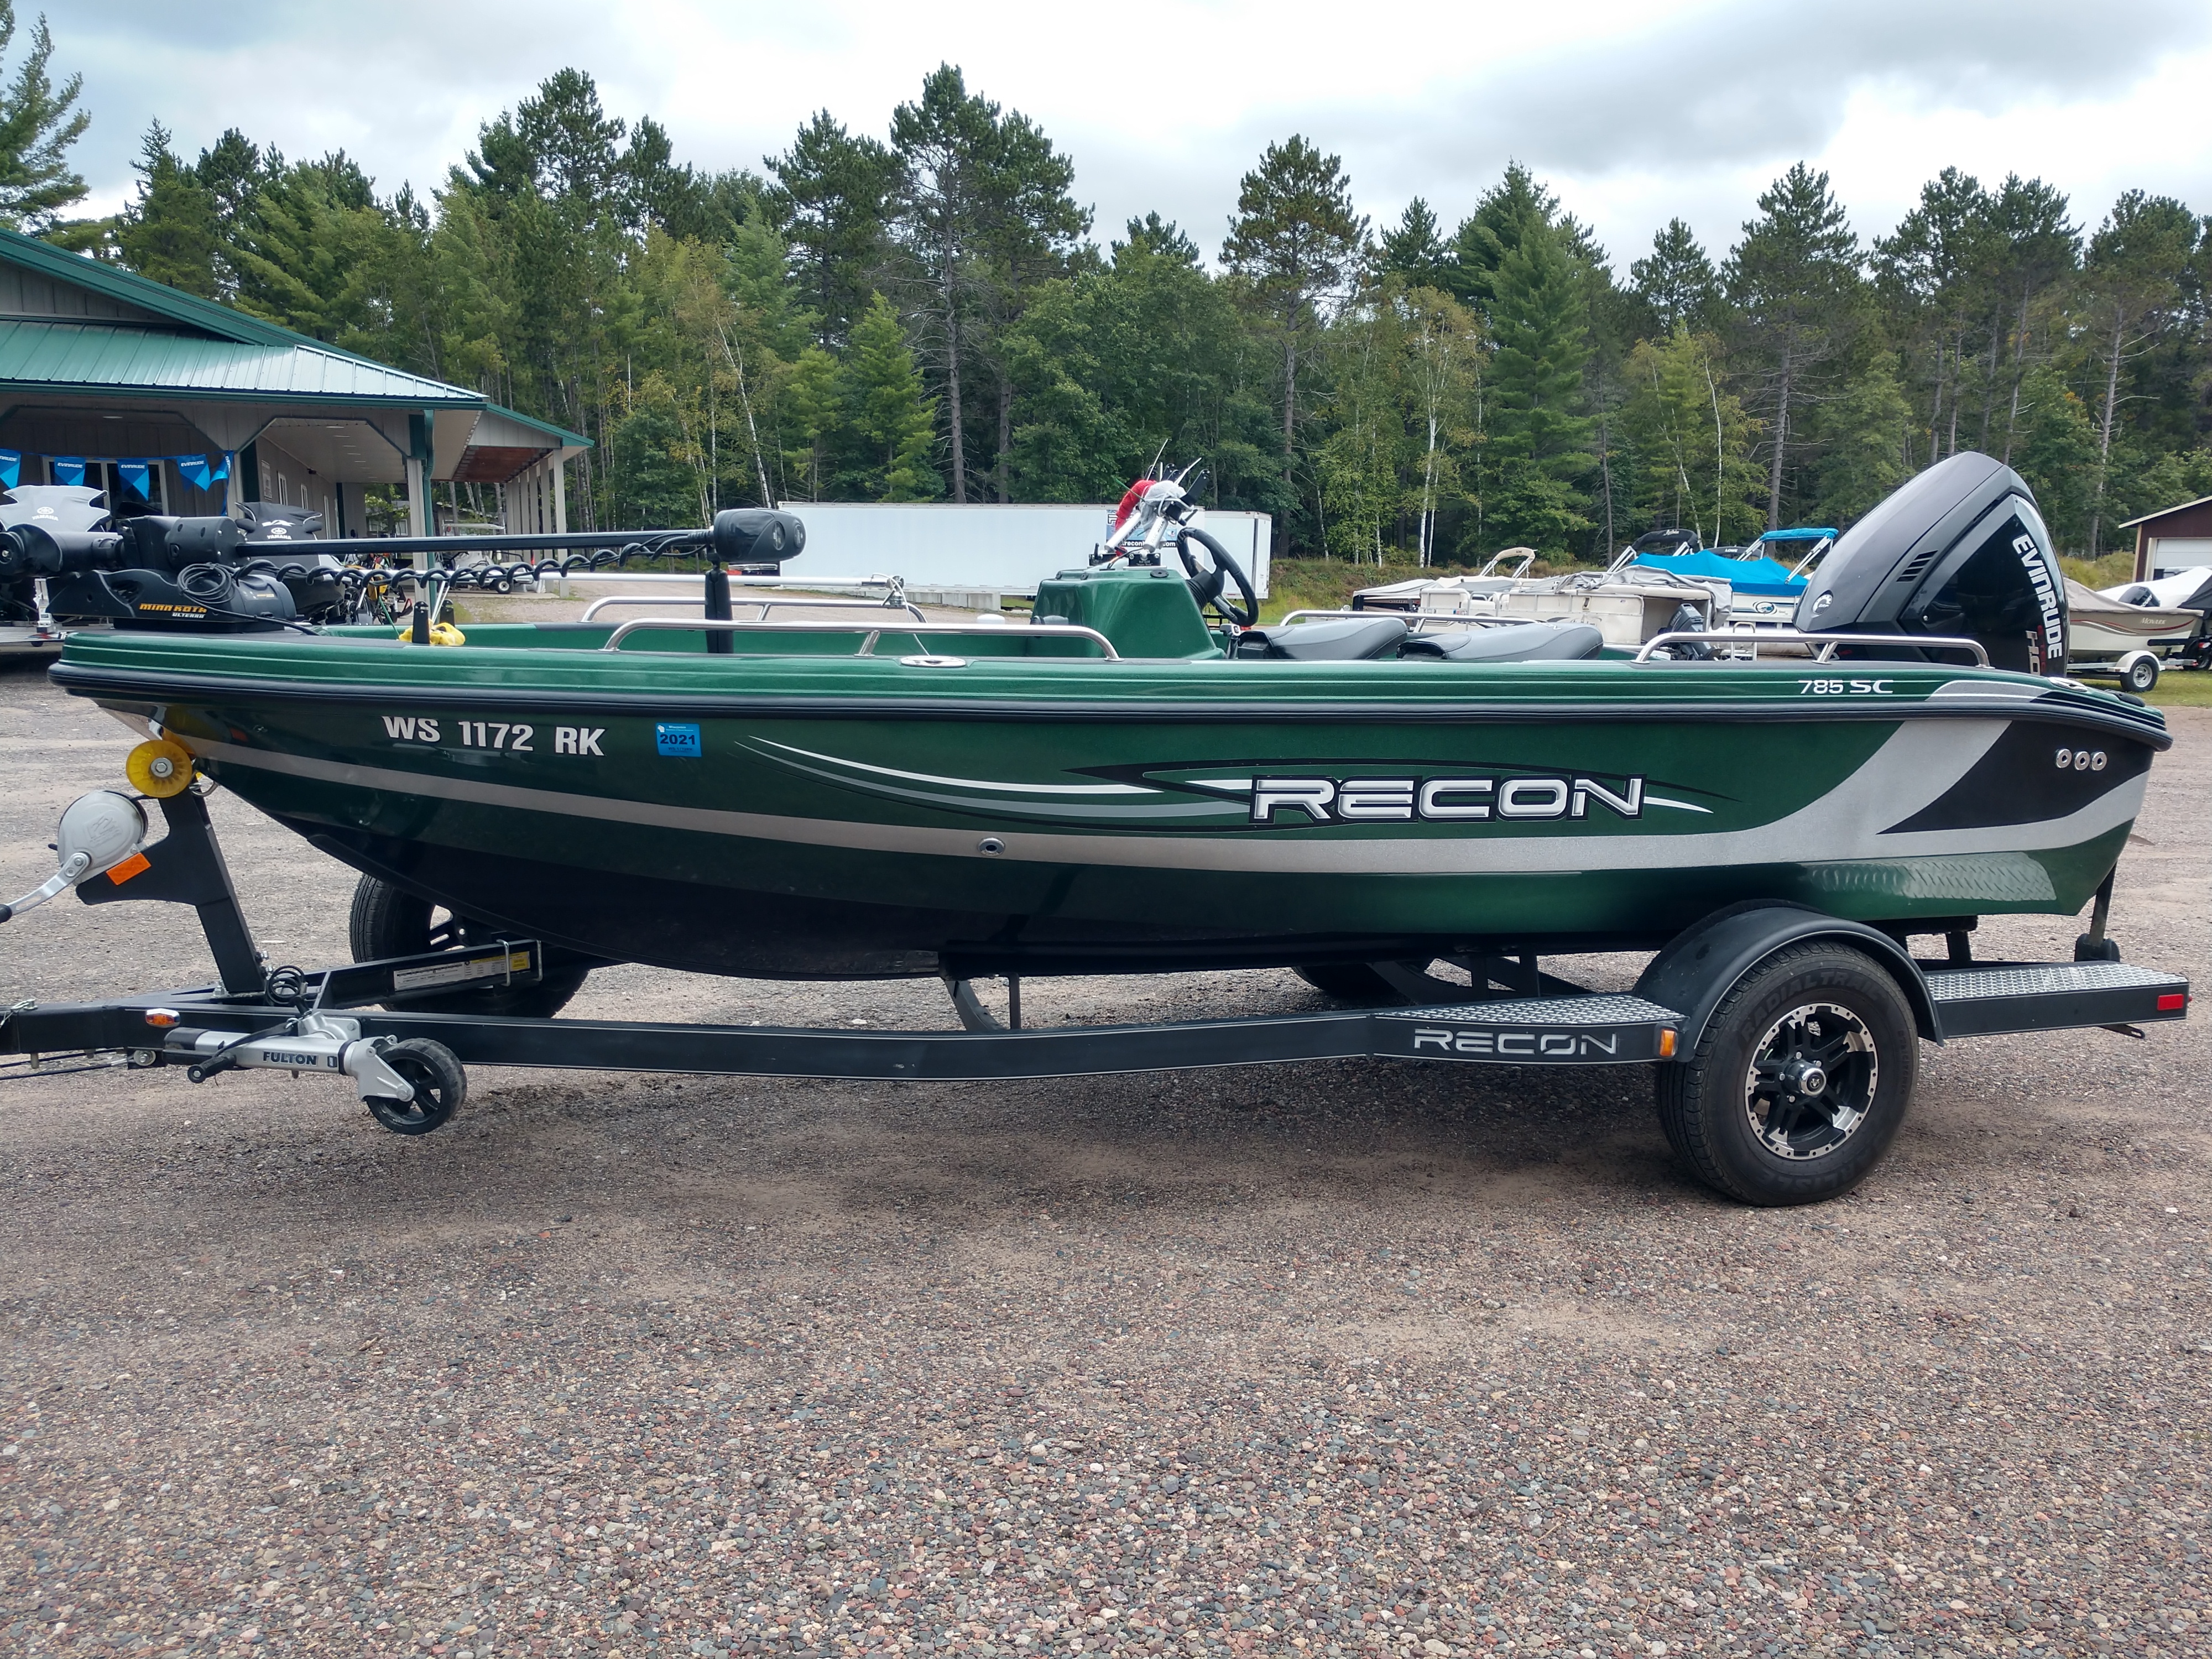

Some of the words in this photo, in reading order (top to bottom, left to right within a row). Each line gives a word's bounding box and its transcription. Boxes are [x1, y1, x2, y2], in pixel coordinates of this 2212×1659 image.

[2012, 533, 2063, 659] EVINRUDE
[2141, 594, 2153, 607] CURY
[139, 603, 173, 612] MINN
[173, 605, 207, 613] KOTA
[1798, 680, 1844, 694] 785
[1850, 680, 1893, 694] SC
[382, 716, 440, 742] WS
[458, 721, 533, 751] 1172
[555, 727, 606, 756] RK
[660, 734, 695, 745] 2021
[1253, 778, 1645, 820] RECON
[1741, 975, 1817, 1042] RADIAL
[1414, 1029, 1617, 1055] RECON
[263, 1051, 317, 1066] FULTON
